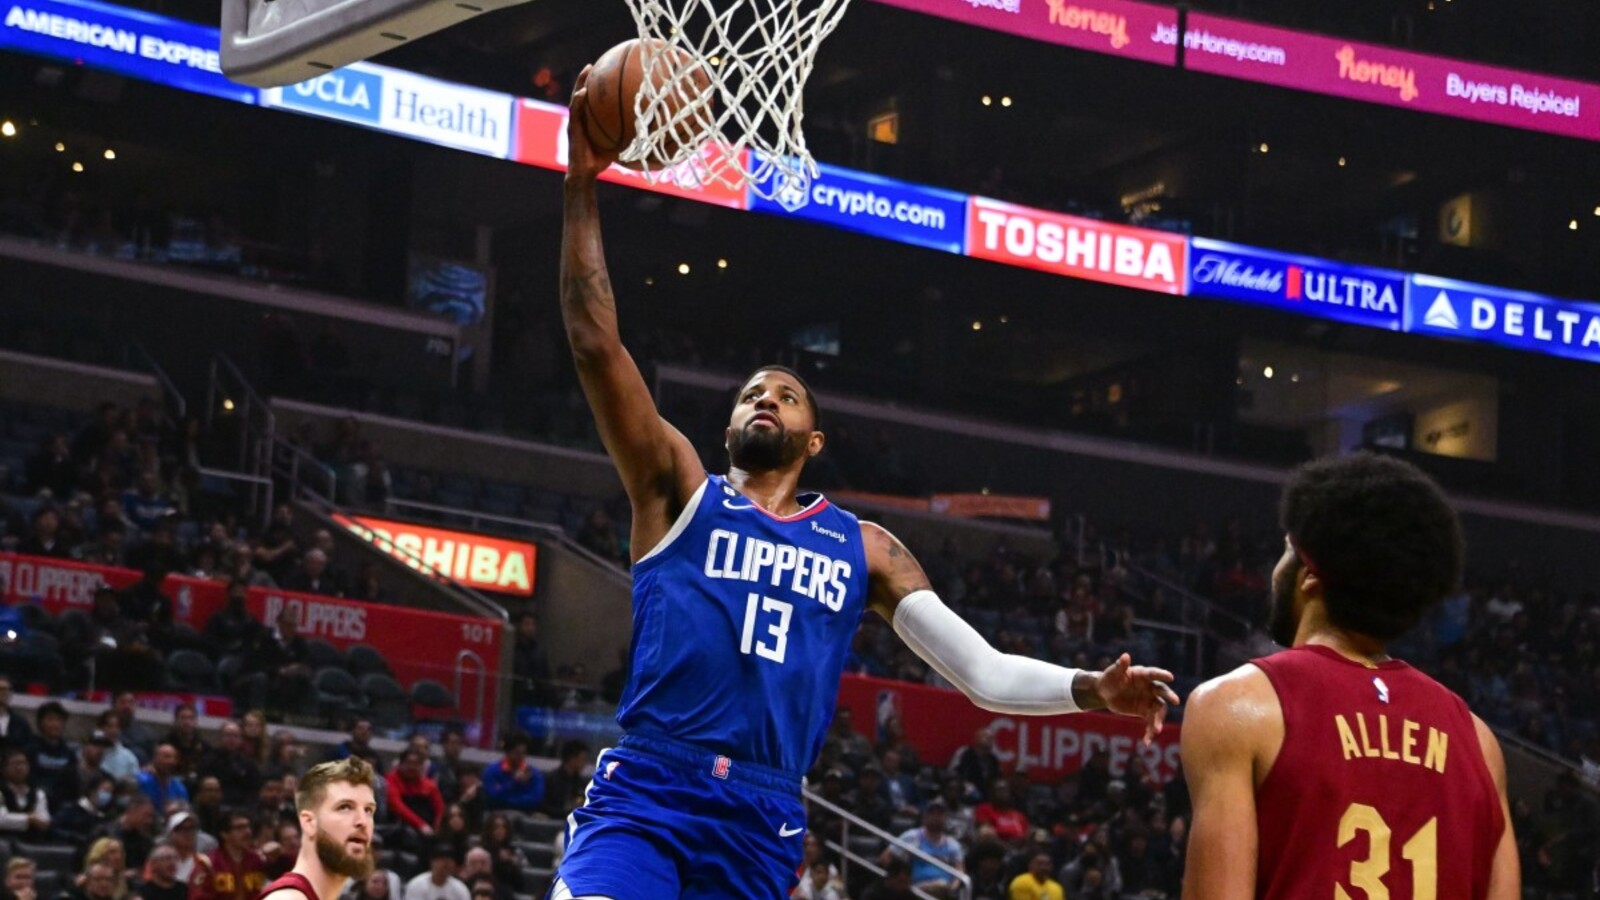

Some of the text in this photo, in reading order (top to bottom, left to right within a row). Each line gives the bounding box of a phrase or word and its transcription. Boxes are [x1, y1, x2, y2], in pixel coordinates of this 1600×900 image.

[5, 6, 223, 75] AMERICAN EXPRE
[1335, 45, 1418, 102] honey
[1446, 73, 1580, 118] Buyers Rejoice!
[392, 88, 498, 141] Health
[812, 183, 946, 230] crypto.com
[978, 208, 1175, 283] TOSHIBA
[1303, 272, 1398, 314] ULTRA
[811, 519, 847, 544] honey
[704, 528, 851, 612] CLIPPERS
[461, 623, 493, 645] 101
[740, 592, 793, 664] 13
[1335, 712, 1448, 774] ALLEN
[1334, 803, 1437, 900] 31
